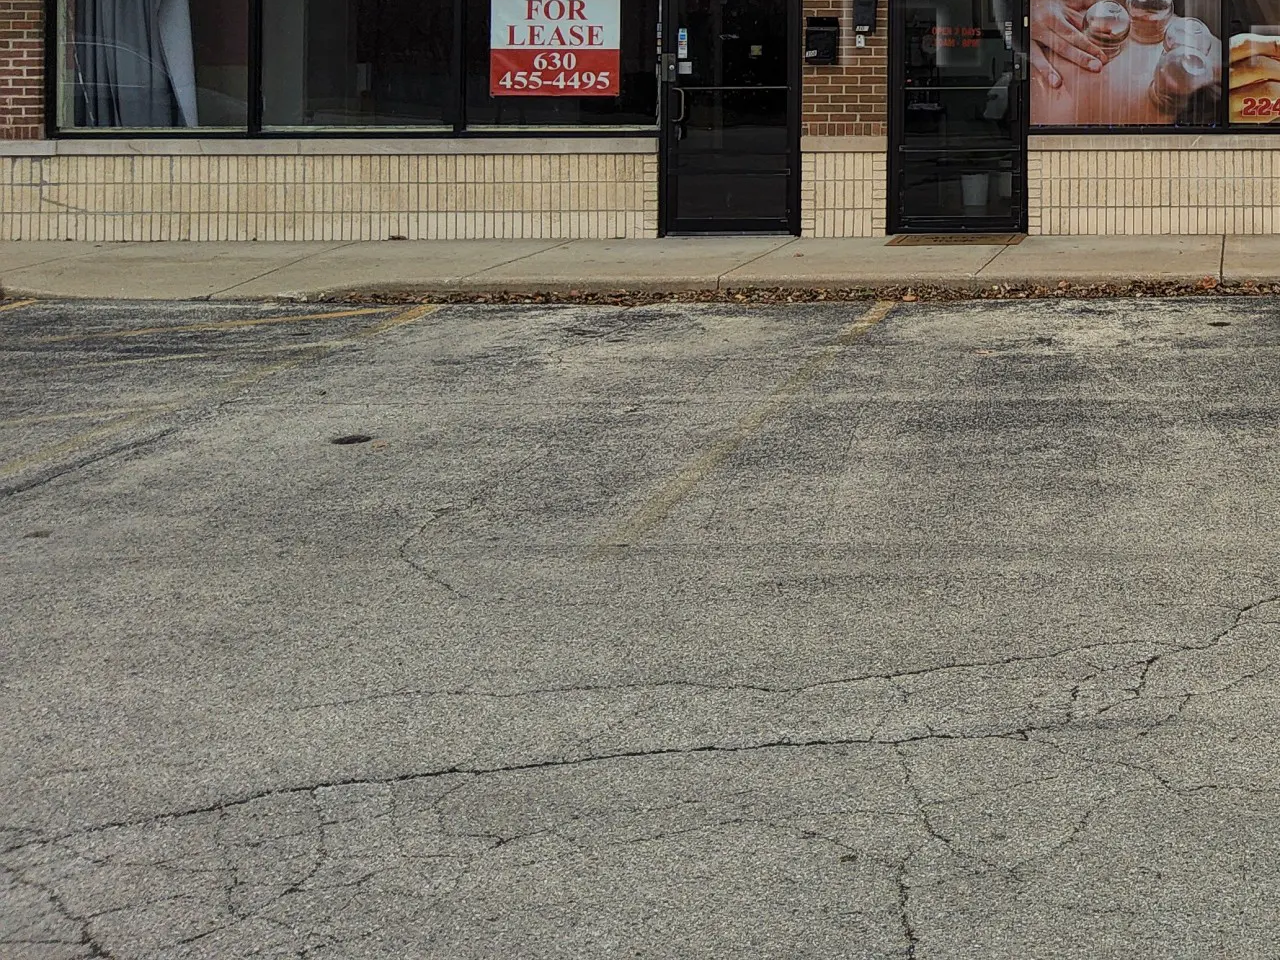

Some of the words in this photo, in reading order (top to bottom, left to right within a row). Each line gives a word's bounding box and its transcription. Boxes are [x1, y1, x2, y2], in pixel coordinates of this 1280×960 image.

[525, 0, 588, 21] FOR
[506, 24, 605, 47] LEASE
[962, 26, 982, 37] DAYS
[533, 52, 577, 71] 630
[499, 71, 611, 90] 455-4495
